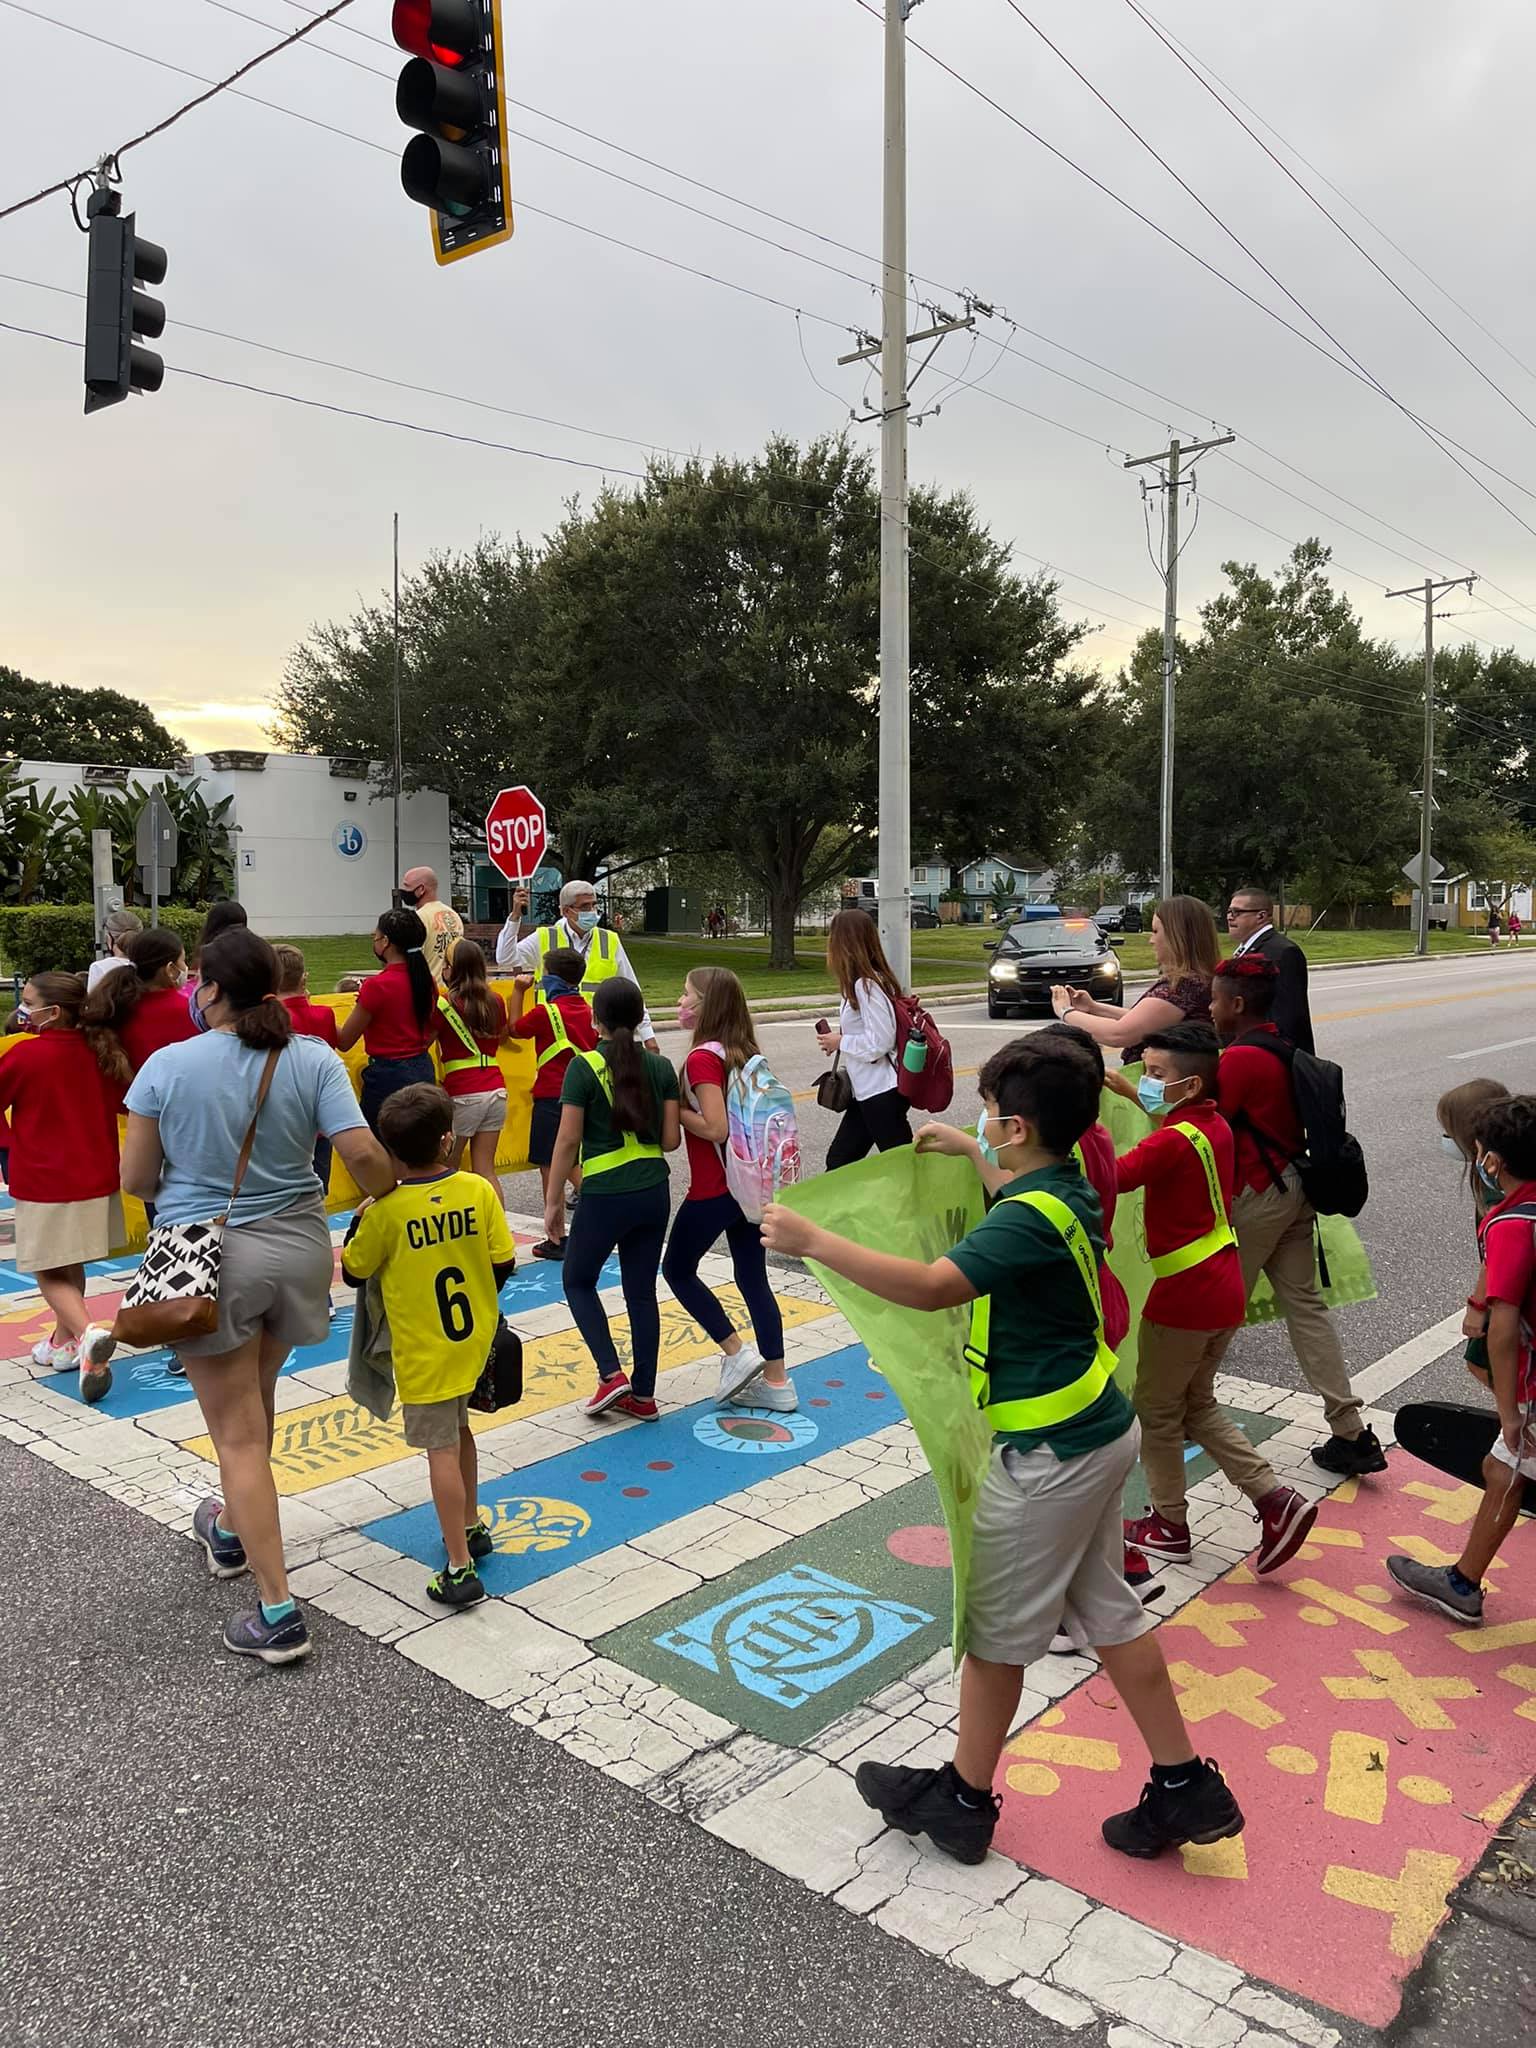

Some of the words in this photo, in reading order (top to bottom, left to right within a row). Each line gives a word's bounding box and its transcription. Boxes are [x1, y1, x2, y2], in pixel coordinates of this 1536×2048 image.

[343, 829, 358, 851] ib
[490, 814, 542, 854] STOP
[244, 854, 252, 866] 1
[406, 1206, 478, 1250] CLYDE
[434, 1266, 475, 1342] 6
